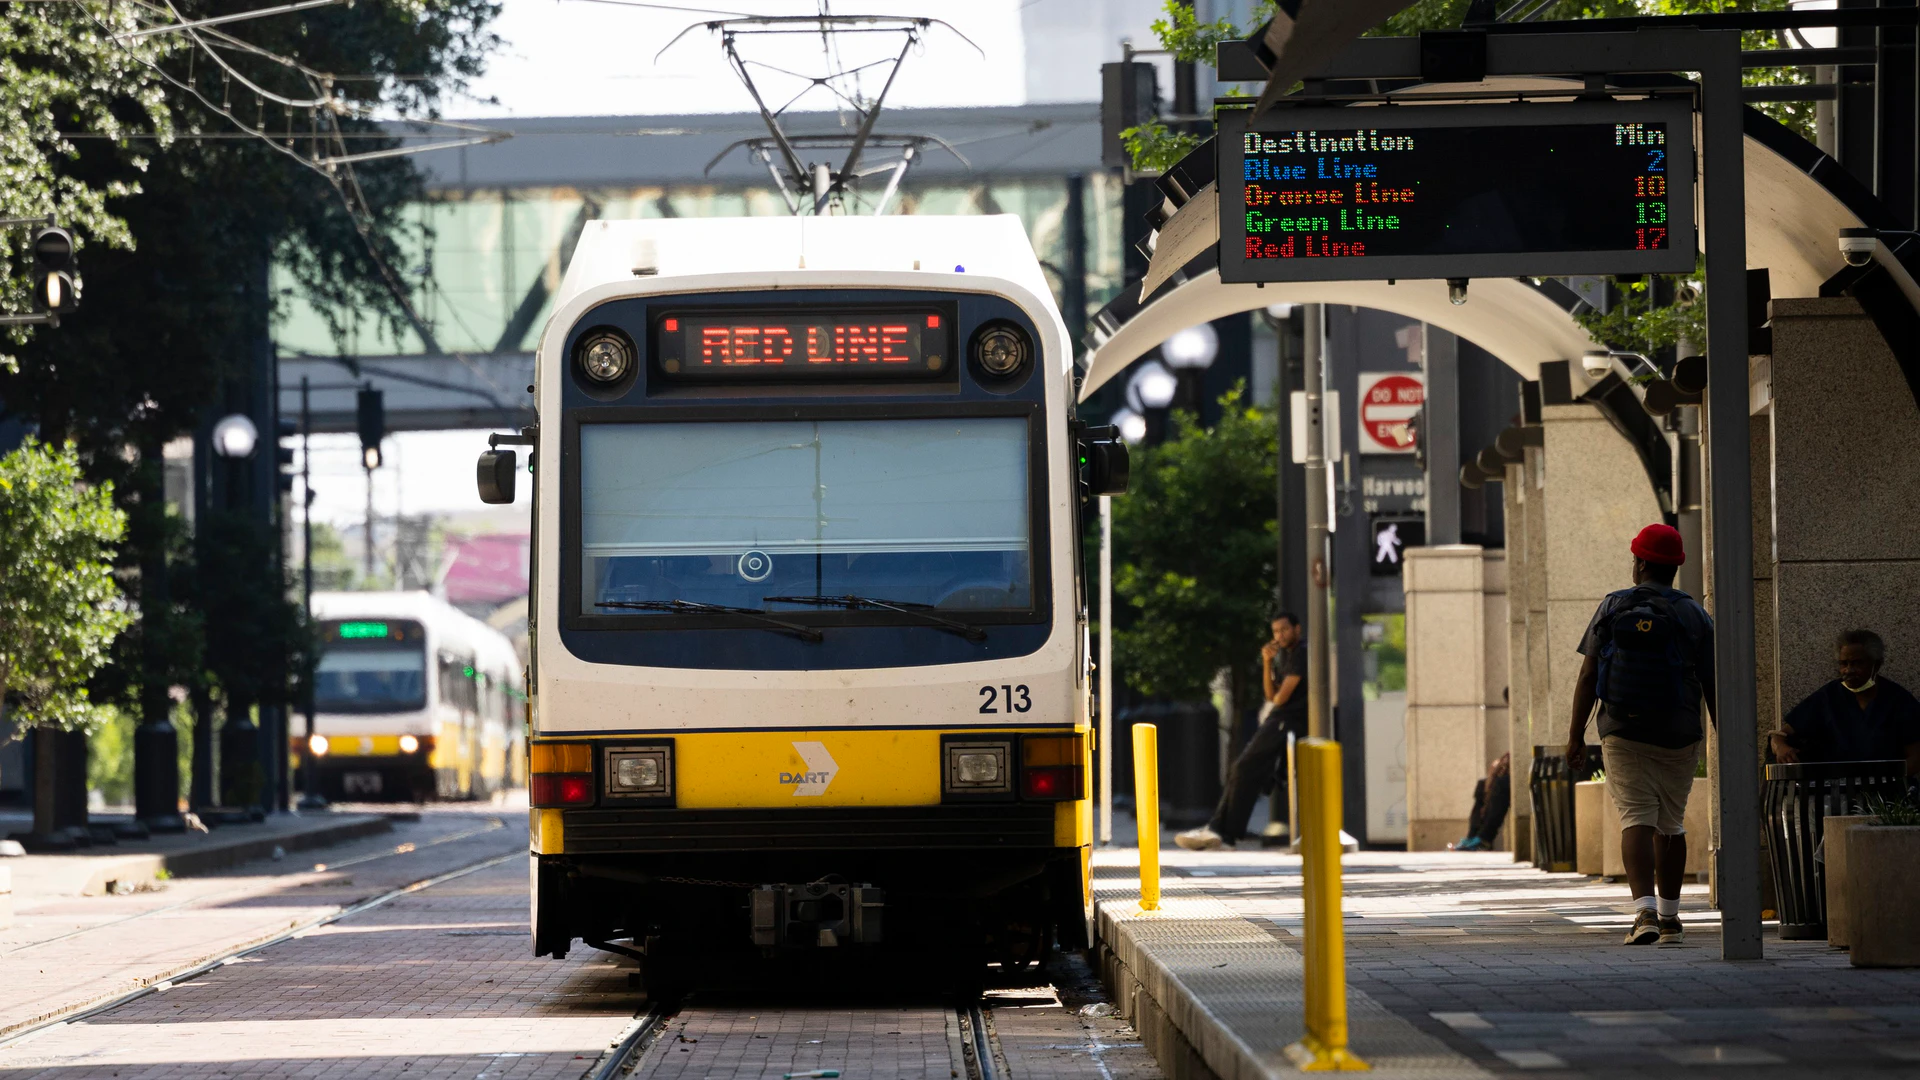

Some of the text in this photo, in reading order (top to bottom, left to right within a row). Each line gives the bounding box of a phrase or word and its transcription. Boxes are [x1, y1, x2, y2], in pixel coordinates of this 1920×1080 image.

[1244, 123, 1665, 154] Destination Min
[1244, 149, 1665, 180] Blue Line 2
[1244, 176, 1665, 206] Orange Line 10
[1246, 202, 1666, 232] Green Line 13
[1245, 228, 1666, 258] Red Line 17
[703, 326, 910, 363] RED LINE
[1372, 387, 1423, 402] DO NOT
[1363, 477, 1424, 496] Harwoo
[979, 684, 1032, 714] 213
[779, 771, 829, 785] DART
